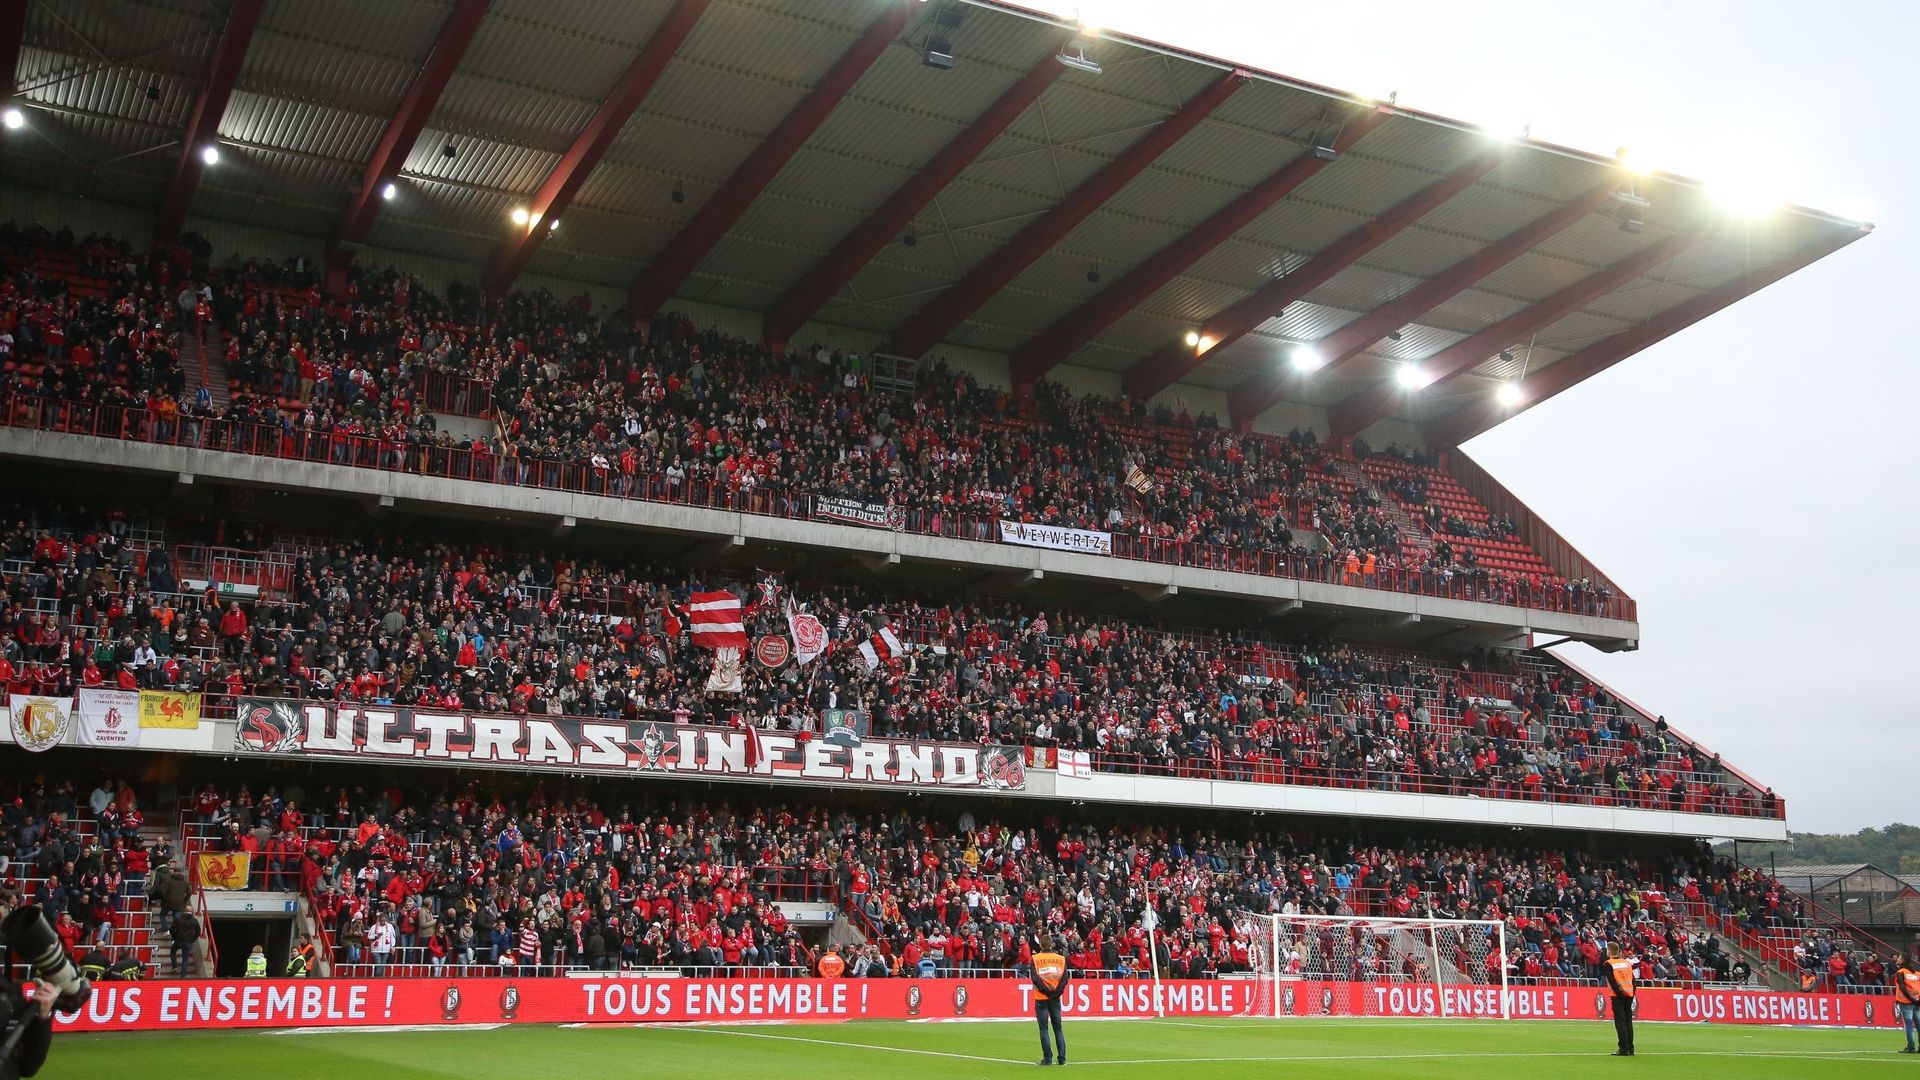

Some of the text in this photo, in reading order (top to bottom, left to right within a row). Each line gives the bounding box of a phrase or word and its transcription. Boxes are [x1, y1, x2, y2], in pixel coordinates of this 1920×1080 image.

[816, 503, 885, 524] INTERDITS
[865, 503, 885, 513] AUX
[302, 706, 980, 785] ULTRAS INFERNO
[289, 901, 295, 912] 1
[828, 912, 834, 920] 2
[159, 985, 368, 1022] ENSEMBLE
[582, 983, 672, 1015] TOUS
[686, 983, 847, 1015] ENSEMBLE
[1018, 983, 1090, 1012] TUS
[1102, 984, 1234, 1012] ENSEMBLE
[1373, 986, 1435, 1015] TOUS
[1443, 988, 1555, 1016] ENSEMBLE
[1672, 993, 1726, 1018] TOUS
[1732, 994, 1829, 1021] ENSEMBLE
